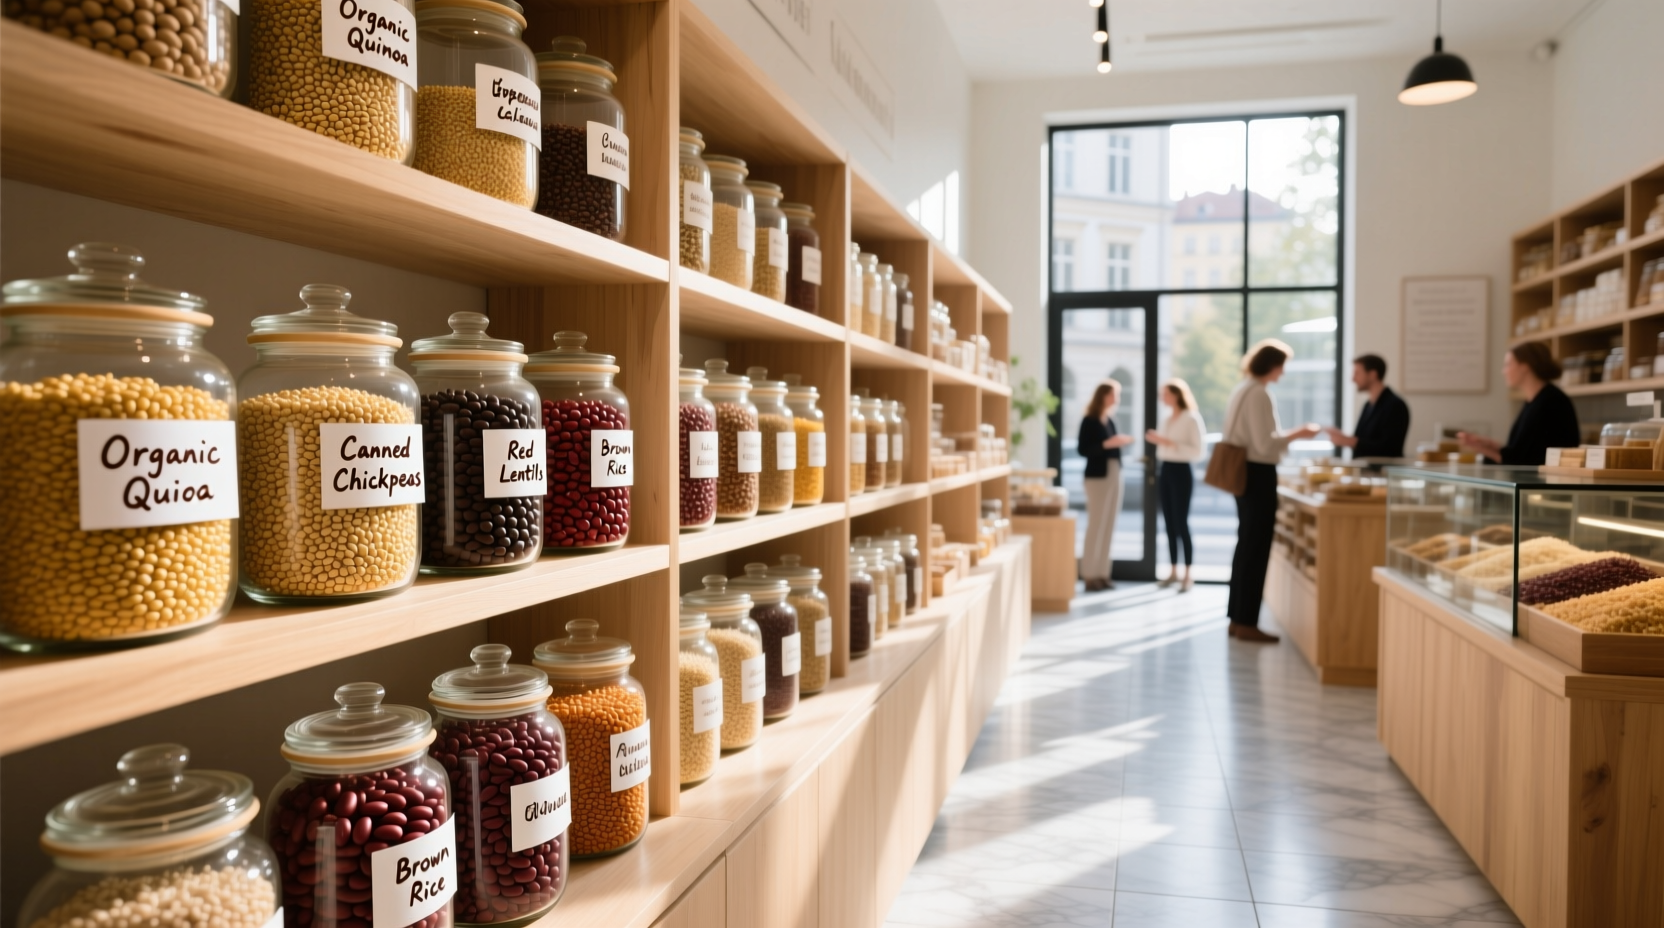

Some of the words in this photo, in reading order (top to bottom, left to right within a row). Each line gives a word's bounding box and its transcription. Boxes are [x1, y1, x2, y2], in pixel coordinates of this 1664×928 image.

[339, 0, 409, 42] Organic
[347, 27, 408, 67] Quinoa
[101, 434, 220, 479] Organic
[340, 435, 410, 461] Canned
[508, 440, 534, 461] Red
[333, 467, 421, 497] Chickpeas
[500, 463, 543, 483] Lentils
[123, 476, 214, 511] Quioa
[396, 847, 449, 884] Brown
[410, 877, 445, 907] Rice
